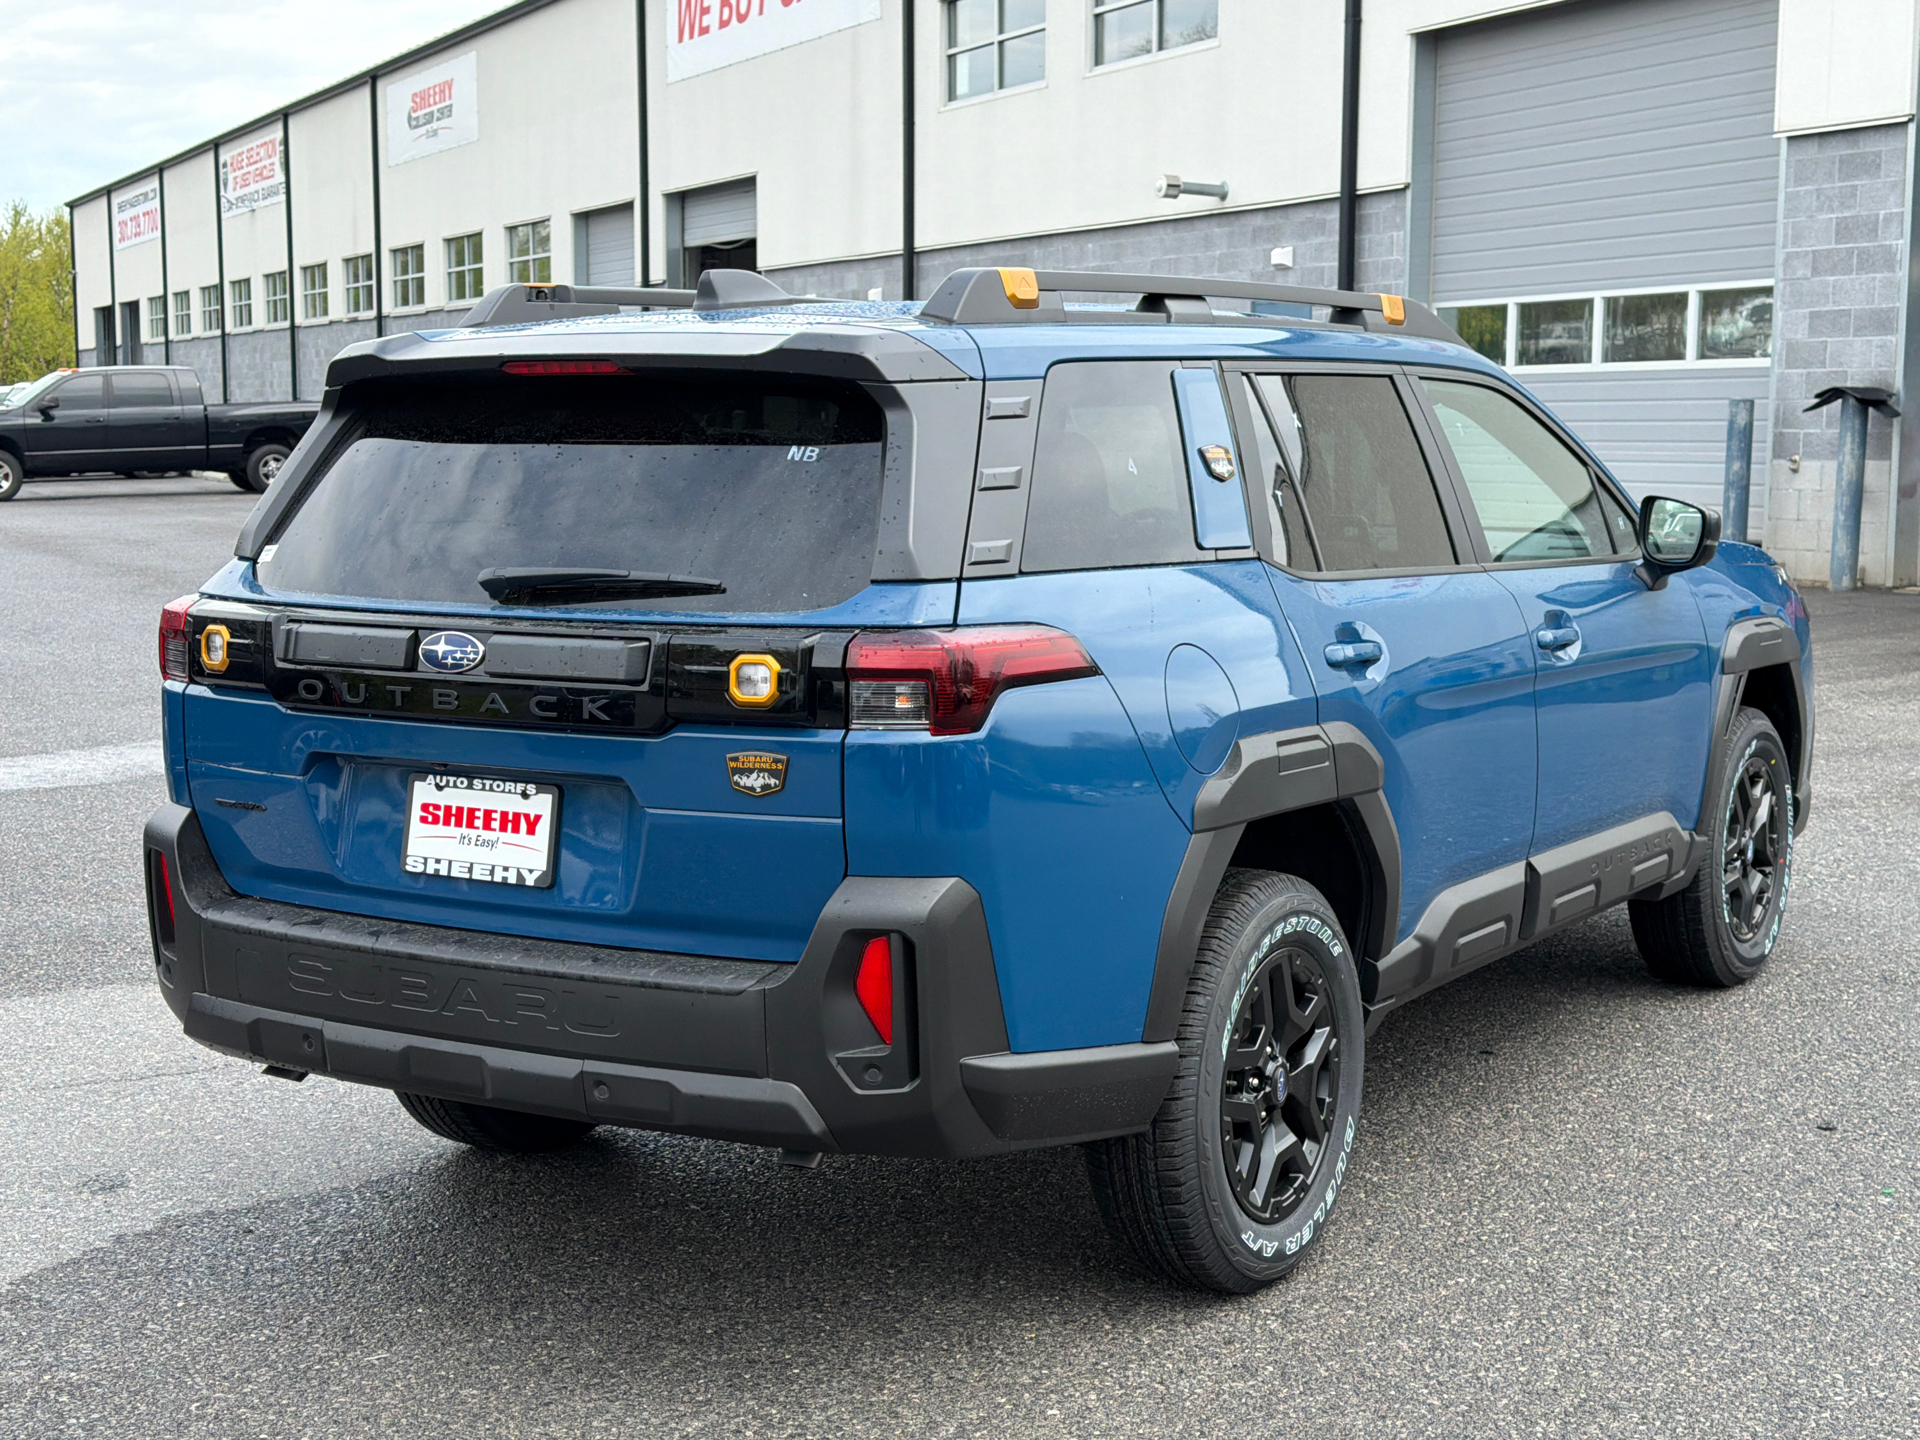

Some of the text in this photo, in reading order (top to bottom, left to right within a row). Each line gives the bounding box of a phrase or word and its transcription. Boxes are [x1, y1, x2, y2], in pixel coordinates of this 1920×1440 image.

[677, 0, 711, 44] WE
[411, 77, 454, 113] SHEEHY
[787, 445, 820, 462] NB
[299, 679, 612, 722] OUTBACK
[729, 761, 784, 770] WILDERNESS
[738, 755, 774, 763] SUBARU
[425, 774, 537, 795] AUTO STORES
[419, 802, 544, 837] SHEEHY
[458, 833, 500, 851] It's Easy!
[1590, 832, 1673, 877] OUTBACK
[405, 855, 544, 887] SHEEHY
[287, 952, 622, 1038] SUBARU
[1241, 1115, 1356, 1257] DUELER A/T
